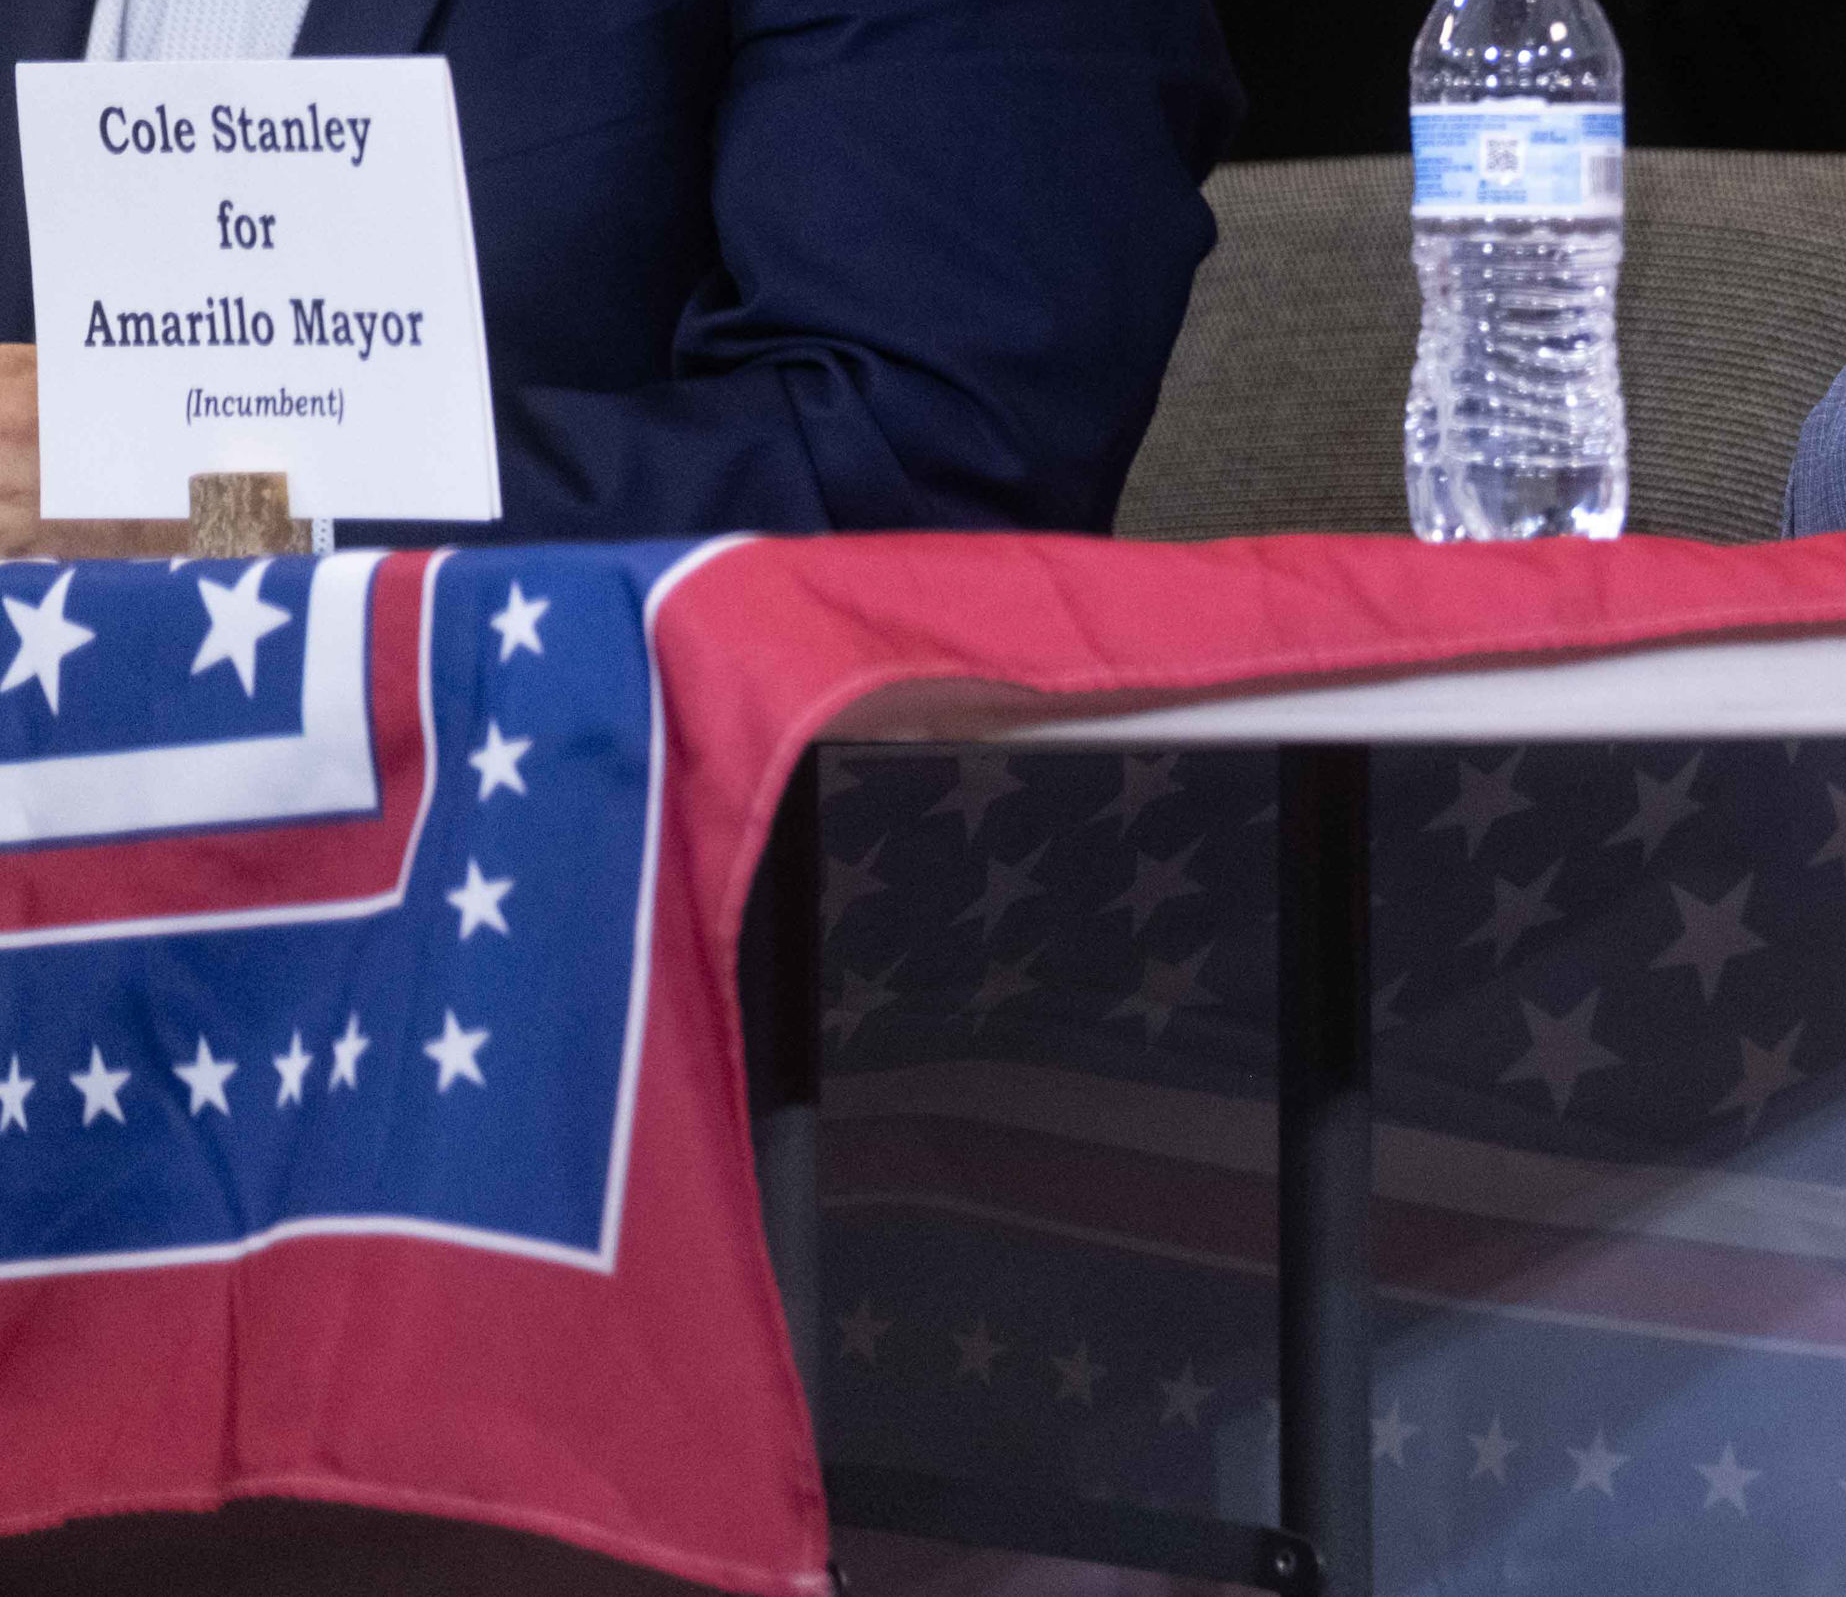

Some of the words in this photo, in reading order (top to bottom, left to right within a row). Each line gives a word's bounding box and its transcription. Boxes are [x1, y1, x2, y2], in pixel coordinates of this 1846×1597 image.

[99, 104, 196, 155] Cole
[210, 102, 372, 167] Stanley
[216, 200, 277, 250] for
[84, 296, 275, 348] Amarillo
[289, 298, 424, 362] Mayor
[186, 387, 344, 425] (Incumbent)
